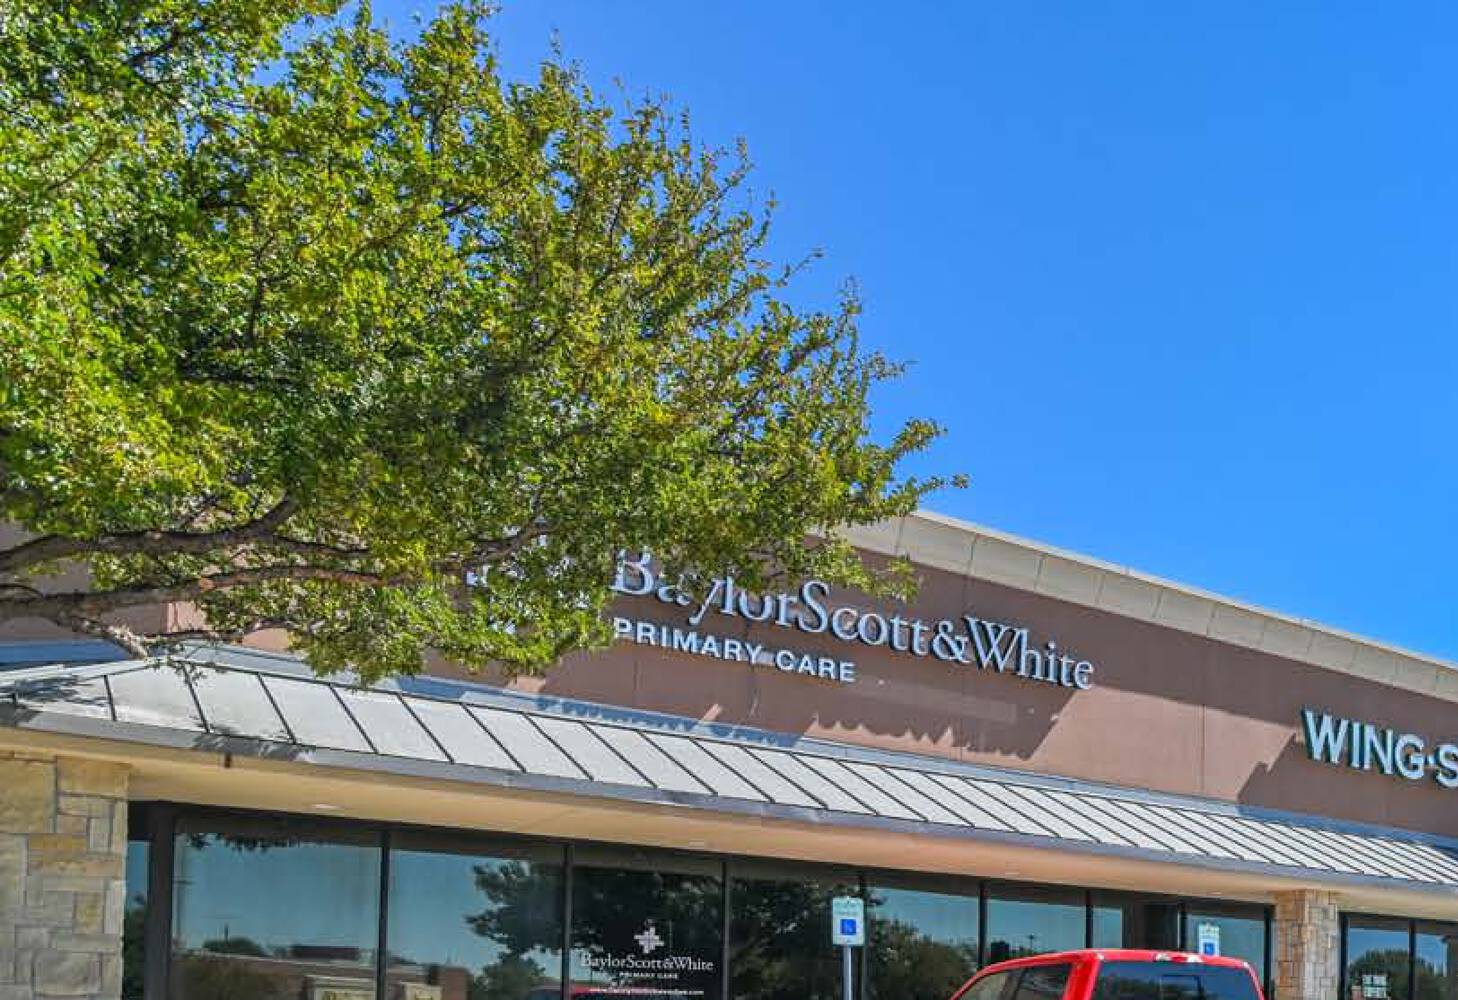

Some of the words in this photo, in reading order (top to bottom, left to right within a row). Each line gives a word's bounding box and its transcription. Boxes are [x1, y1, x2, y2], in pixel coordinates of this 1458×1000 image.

[613, 616, 763, 664] PRIMARY
[775, 649, 857, 683] CARE
[580, 952, 714, 971] BaylorScott&White
